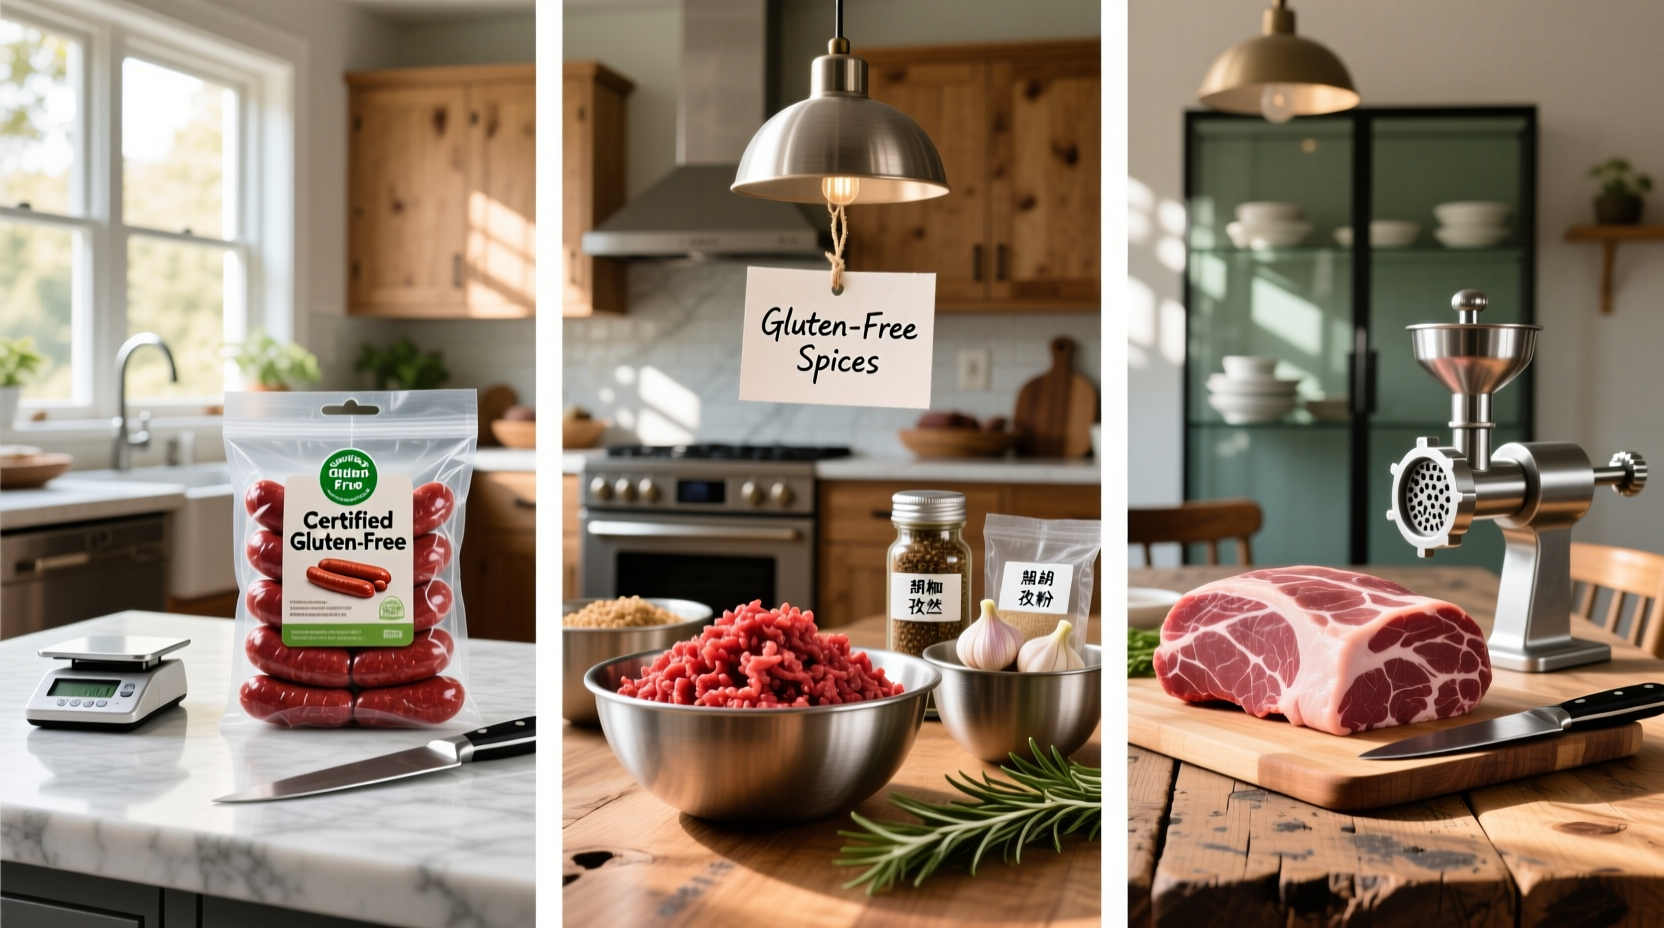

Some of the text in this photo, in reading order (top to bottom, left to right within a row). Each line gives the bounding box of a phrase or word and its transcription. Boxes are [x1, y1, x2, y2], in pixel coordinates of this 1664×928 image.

[761, 306, 918, 342] Gluten-Free
[796, 344, 879, 385] Spices
[303, 510, 393, 530] Certified
[290, 532, 407, 551] Gluten-Free
